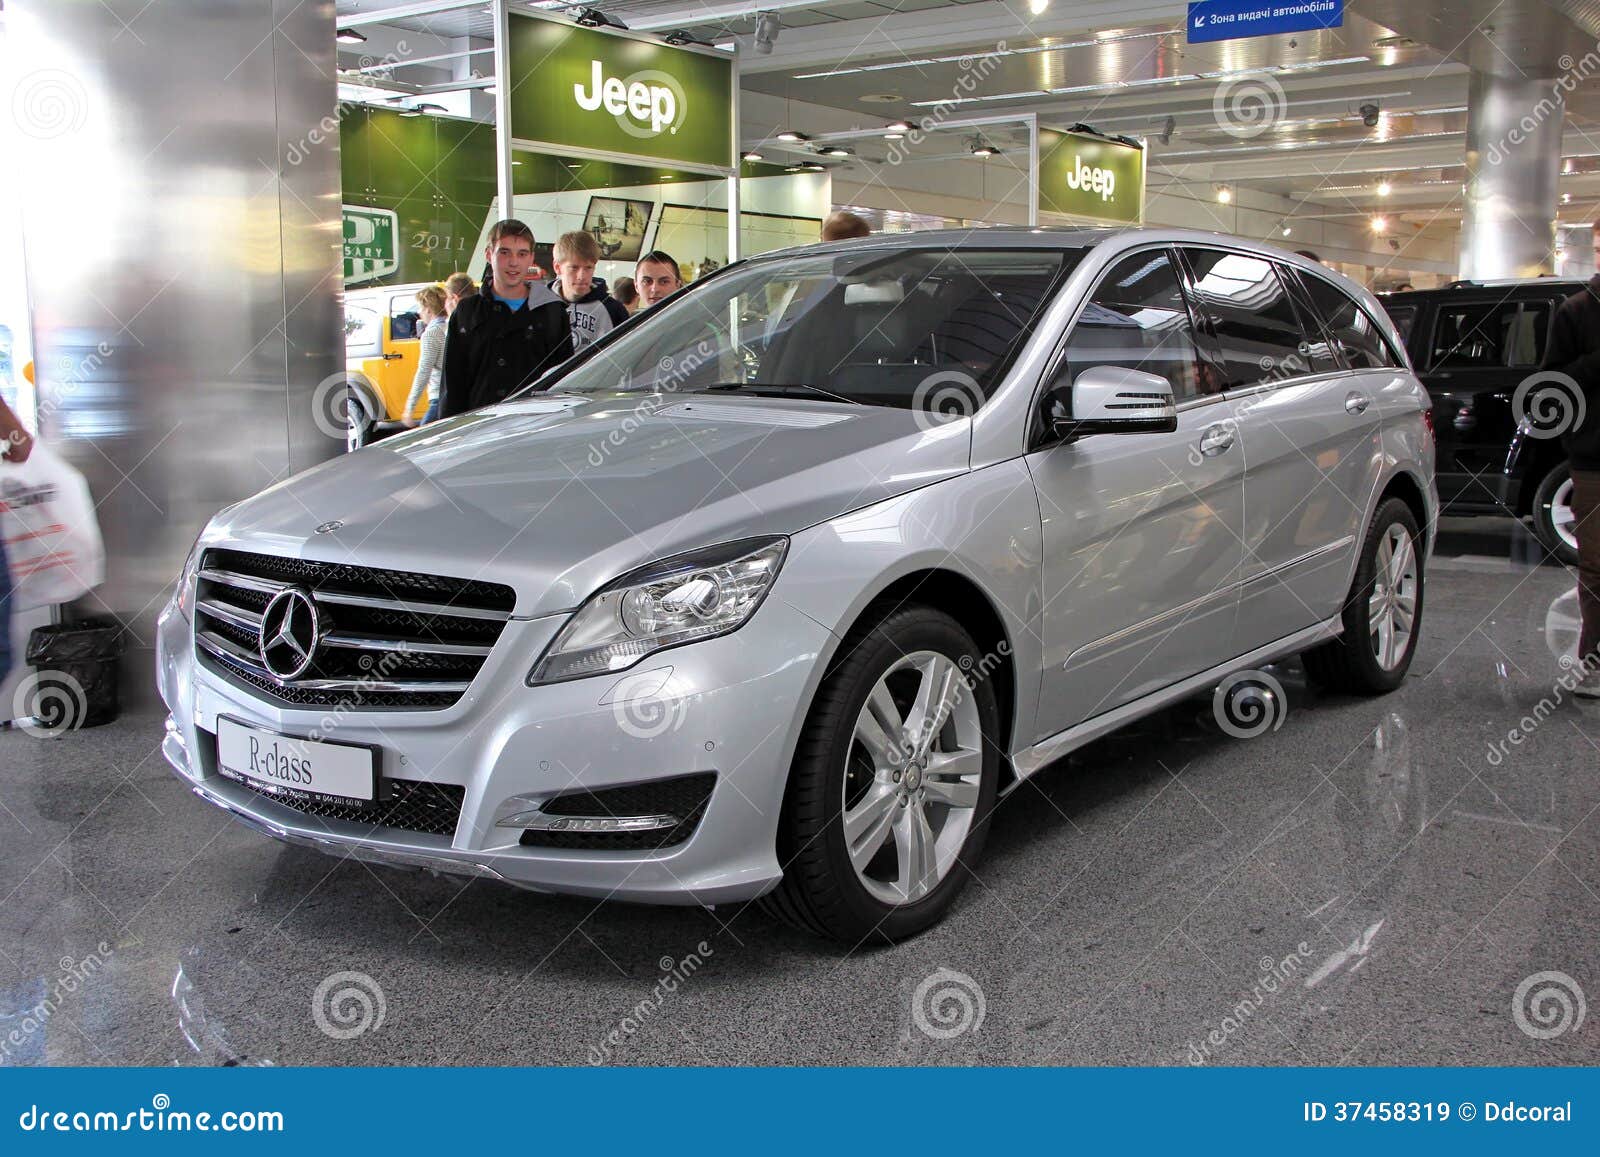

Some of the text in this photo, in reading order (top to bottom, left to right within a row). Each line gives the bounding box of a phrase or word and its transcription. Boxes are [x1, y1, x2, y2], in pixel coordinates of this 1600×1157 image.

[1210, 1, 1335, 25] Зона видачі автомобілів
[574, 60, 676, 132] Jeep
[1067, 155, 1115, 201] Jeep
[411, 233, 465, 251] 2011
[249, 735, 313, 785] R-class
